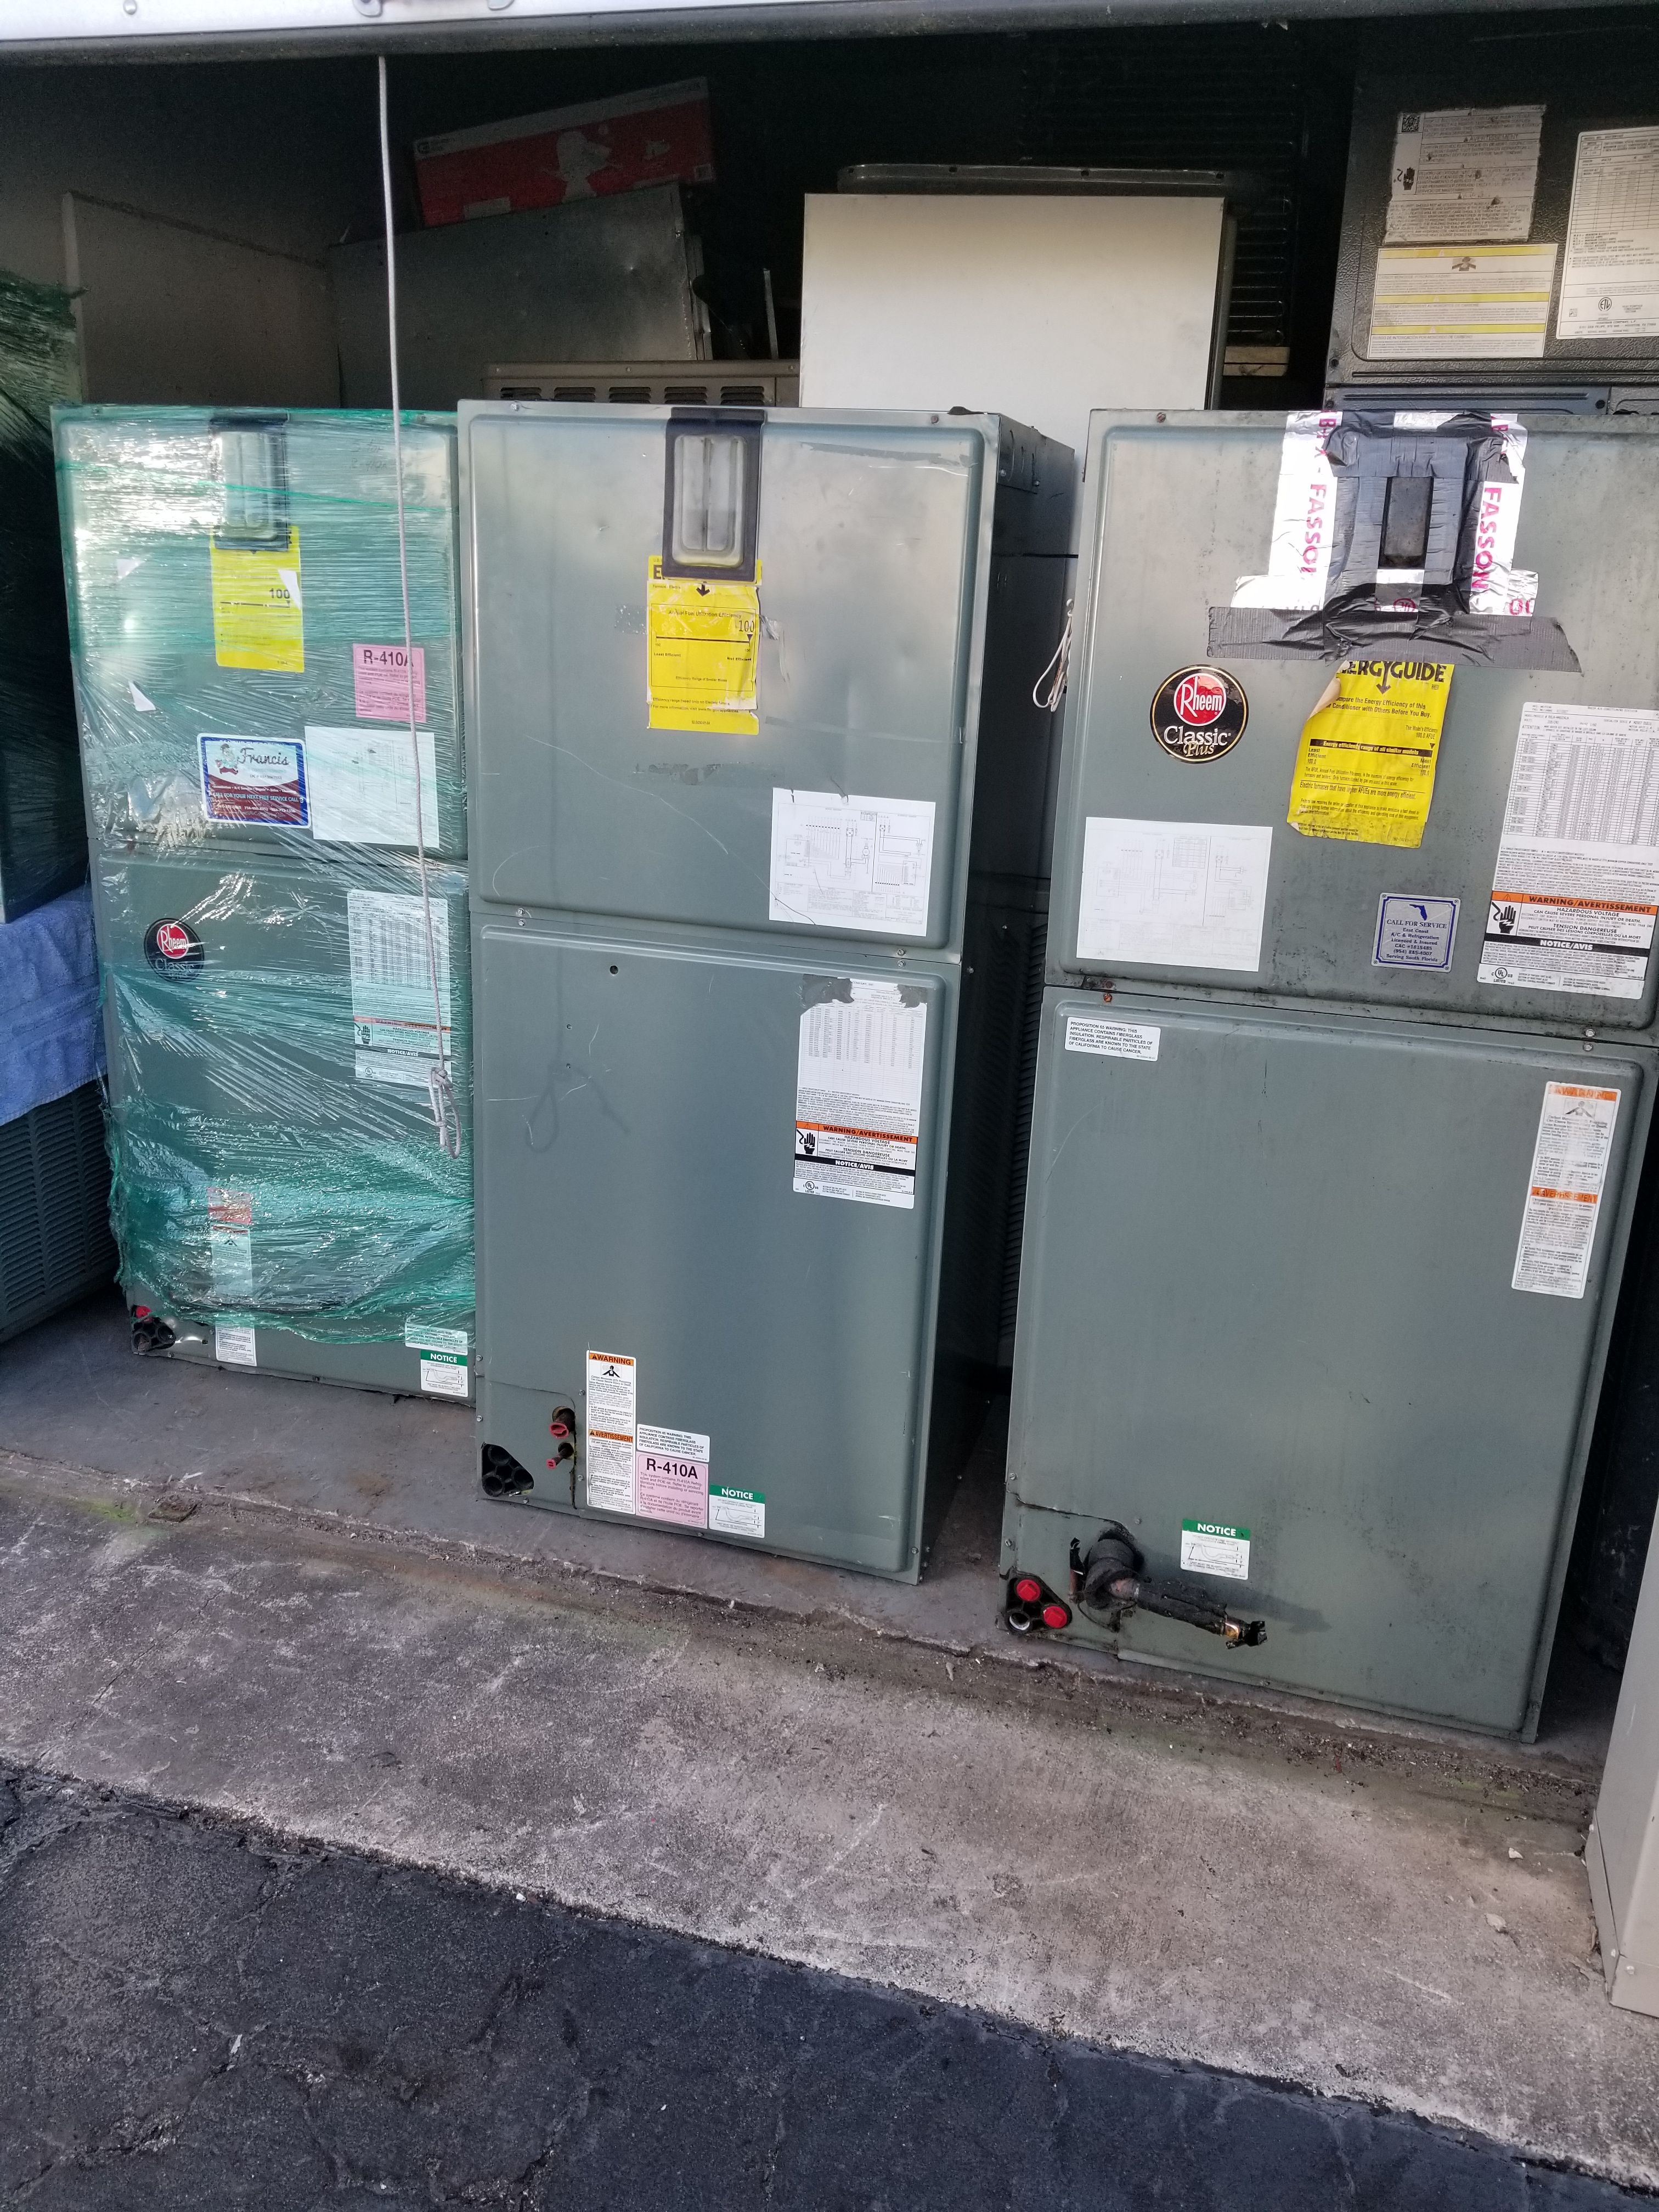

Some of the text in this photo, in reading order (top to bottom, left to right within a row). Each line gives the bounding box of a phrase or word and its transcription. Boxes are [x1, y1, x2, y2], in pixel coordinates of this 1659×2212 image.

[1472, 487, 1503, 592] FASSON
[269, 588, 290, 599] 100
[738, 620, 754, 631] 100
[1181, 676, 1222, 718] Rheem
[1164, 726, 1228, 746] Classic
[238, 748, 290, 765] Francis
[1183, 741, 1215, 757] Plus
[1529, 895, 1651, 913] WARNING/AVERTISSEMENT
[160, 926, 186, 953] Rheem
[1541, 940, 1593, 951] NOTICE/AVIS
[823, 1125, 912, 1142] WARNING/AVERTISSEMENT
[836, 1160, 874, 1170] NOTICE/AVIS
[431, 1353, 457, 1363] NOTICE
[597, 1355, 631, 1365] WARNING
[596, 1431, 633, 1442] AVERTISSEMENT
[647, 1458, 698, 1479] R-410A
[721, 1488, 753, 1500] NOTICE
[1197, 1523, 1236, 1537] NOTICE
